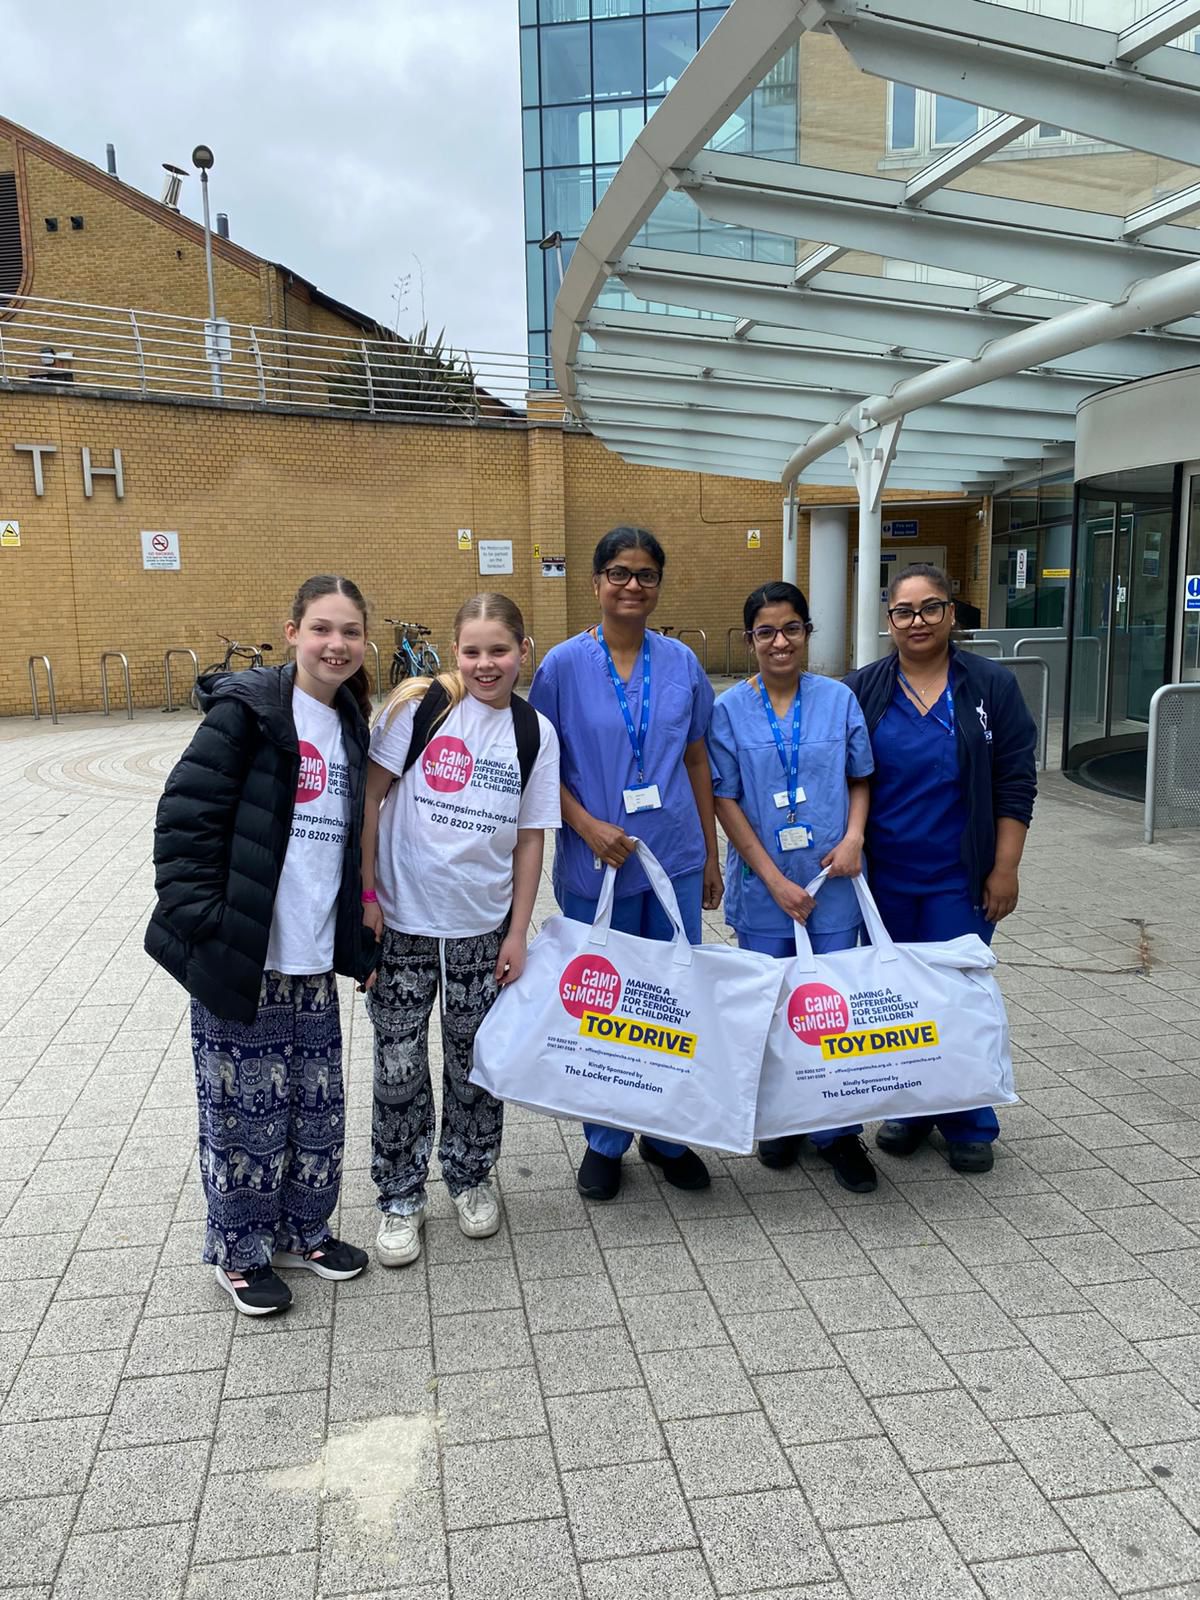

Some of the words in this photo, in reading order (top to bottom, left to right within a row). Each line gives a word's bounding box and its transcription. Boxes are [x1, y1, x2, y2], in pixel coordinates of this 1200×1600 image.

[475, 758, 506, 769] MAKING
[472, 773, 489, 782] FOR
[489, 776, 521, 788] SERIOUS
[474, 766, 520, 780] DIFFERENCE
[483, 782, 521, 796] CHILDREN
[431, 813, 448, 824] 020
[450, 818, 474, 831] 8202
[475, 823, 497, 835] 9297
[308, 830, 330, 842] 8202
[626, 978, 662, 993] MAKING
[663, 988, 671, 996] A
[849, 990, 884, 1001] MAKING
[885, 987, 893, 995] A
[624, 987, 679, 1006] DIFFERENCE
[850, 994, 903, 1009] DIFFERENCE
[621, 1004, 634, 1014] ILL
[636, 1006, 682, 1024] CHILDREN
[623, 996, 641, 1006] FOR
[643, 1000, 691, 1018] SERIOUSLY
[852, 1007, 871, 1017] FOR
[871, 1000, 919, 1015] SERIOUSLY
[854, 1017, 866, 1025] ILL
[868, 1011, 914, 1023] CHILDREN
[586, 1015, 627, 1039] TOY
[629, 1024, 693, 1053] DRIVE
[824, 1035, 866, 1055] TOY
[869, 1025, 934, 1050] DRIVE
[565, 1065, 581, 1077] The
[582, 1069, 611, 1083] Locker
[613, 1075, 663, 1093] Foundation
[588, 1061, 606, 1071] Kindly
[606, 1066, 635, 1078] Sponsored
[635, 1072, 643, 1080] by
[822, 1090, 839, 1099] The
[840, 1087, 869, 1098] Locker
[871, 1079, 922, 1093] Foundation
[842, 1079, 861, 1088] Kindly
[861, 1075, 891, 1086] Sponsored
[892, 1074, 899, 1082] by
